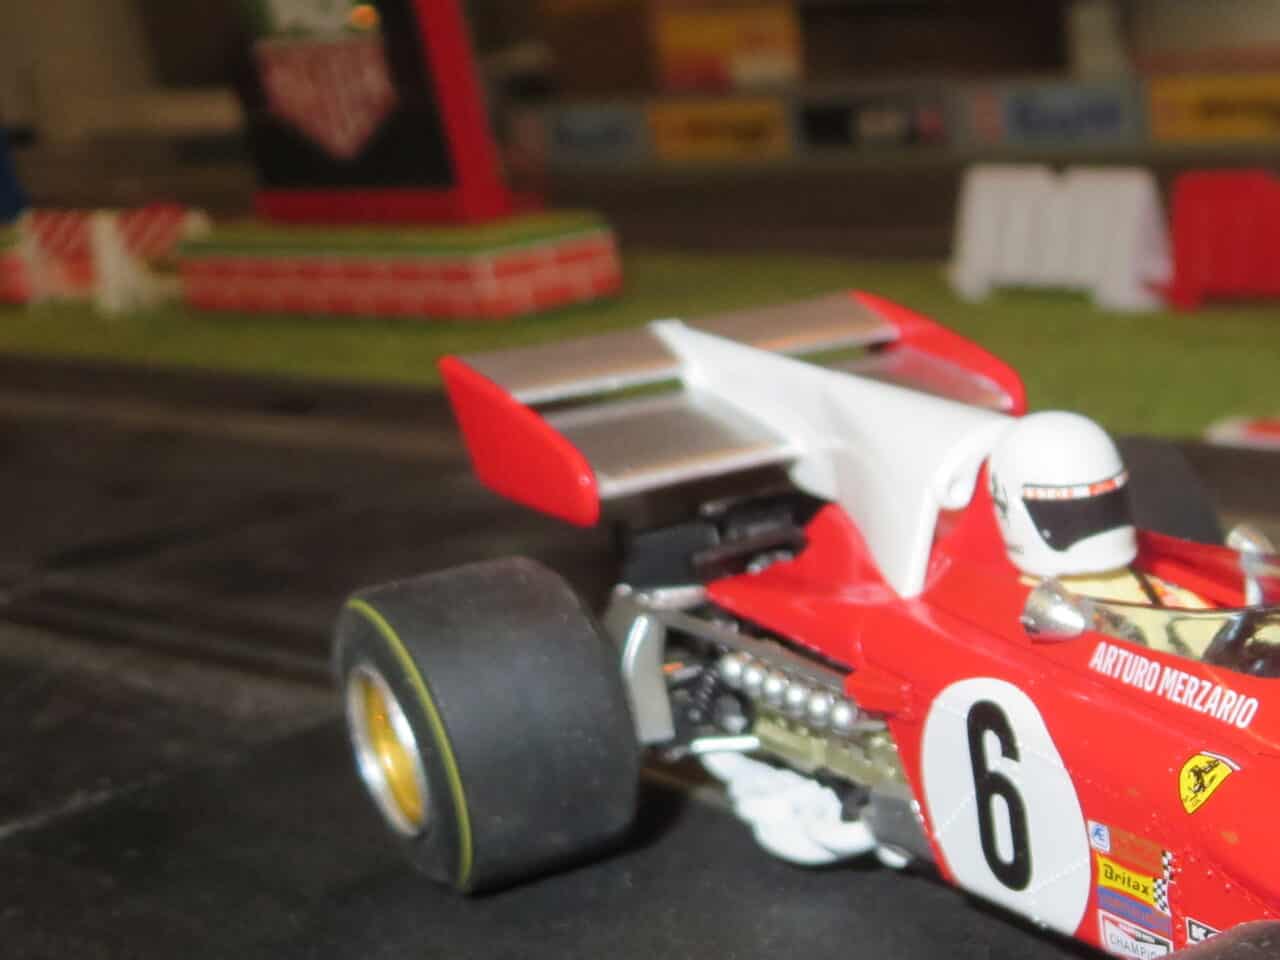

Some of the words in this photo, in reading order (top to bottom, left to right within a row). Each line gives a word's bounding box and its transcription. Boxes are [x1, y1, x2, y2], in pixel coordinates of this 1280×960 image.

[1088, 640, 1162, 693] ARTURO
[1156, 666, 1260, 730] MERZARIO
[966, 699, 1033, 892] 6
[1102, 862, 1151, 897] Britax
